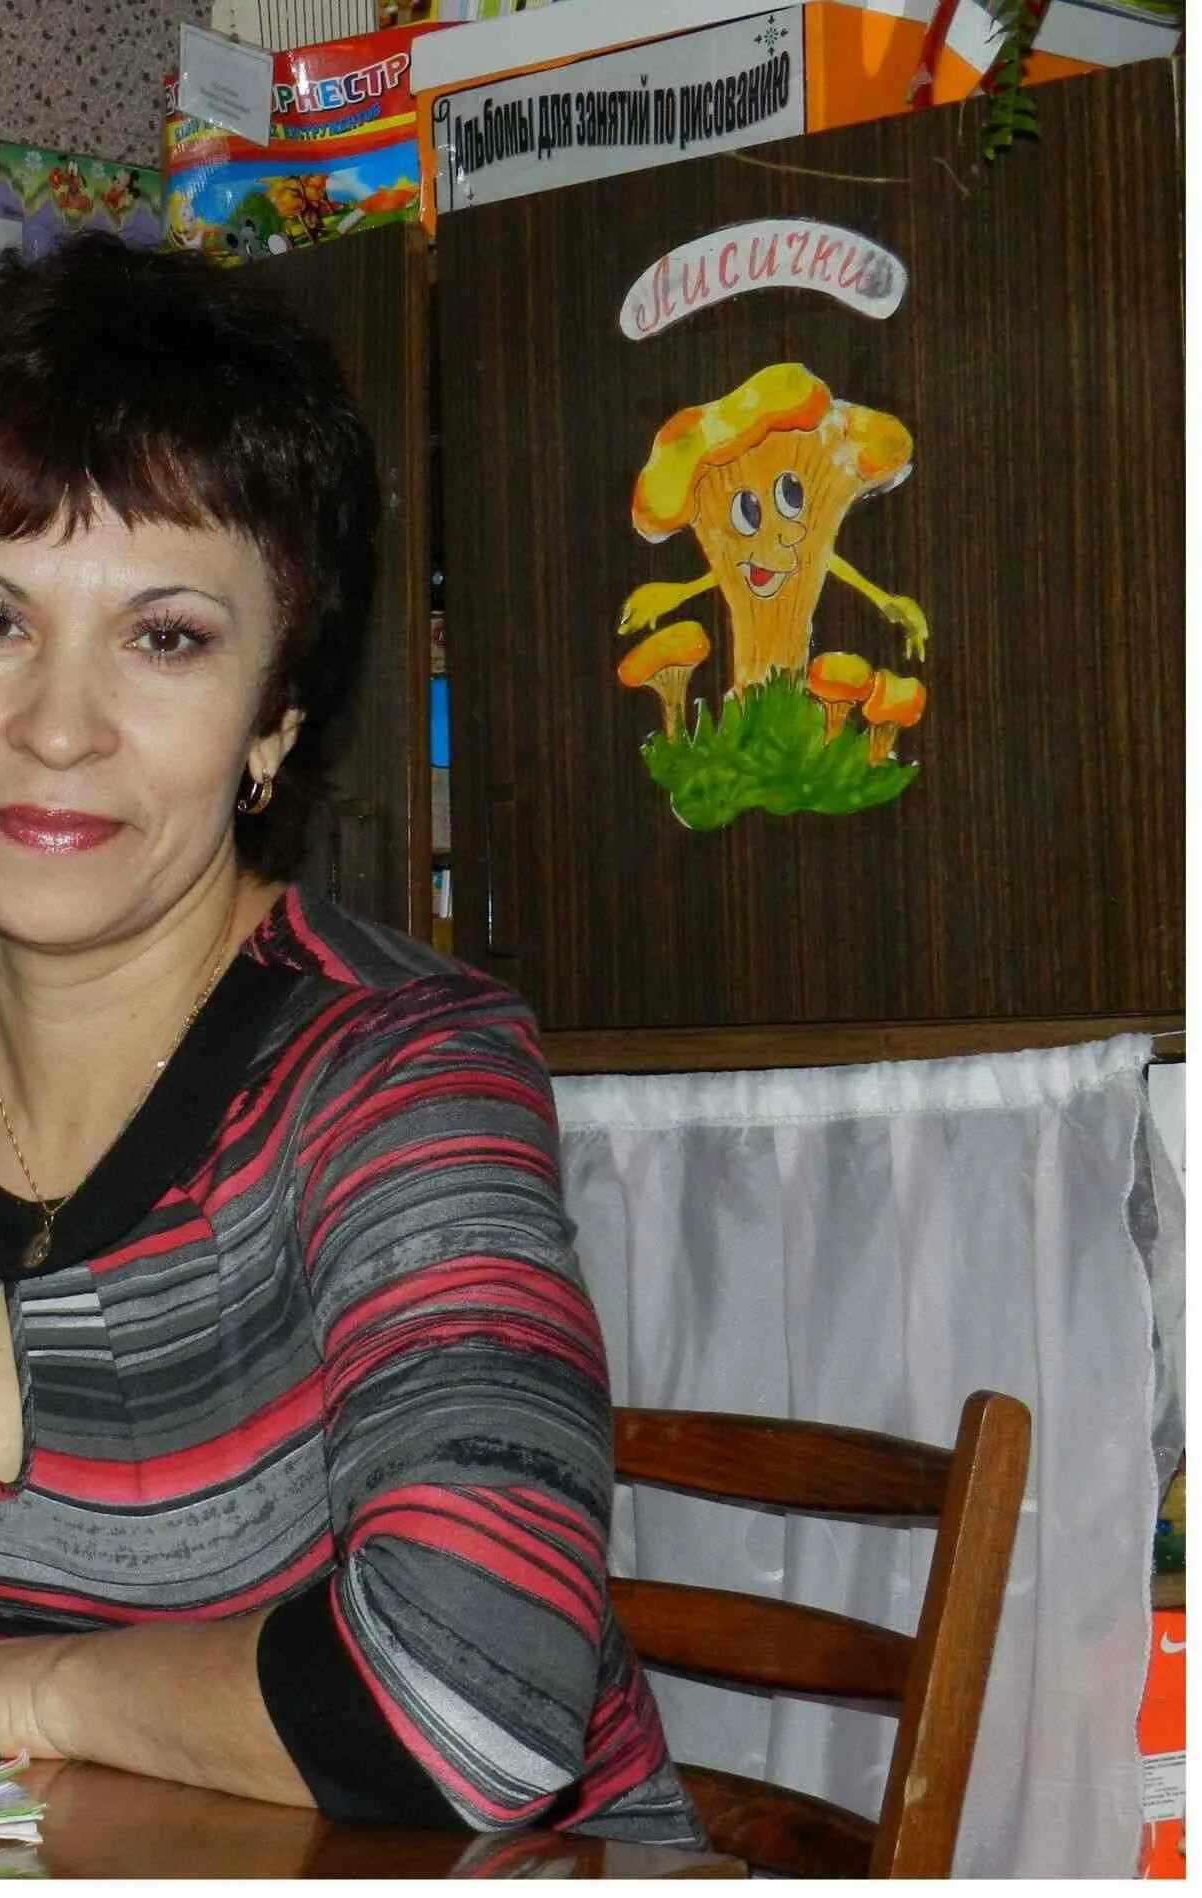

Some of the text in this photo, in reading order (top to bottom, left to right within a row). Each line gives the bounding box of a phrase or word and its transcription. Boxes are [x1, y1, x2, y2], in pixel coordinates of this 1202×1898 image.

[454, 50, 791, 175] Альбомы для занятий по рисованию
